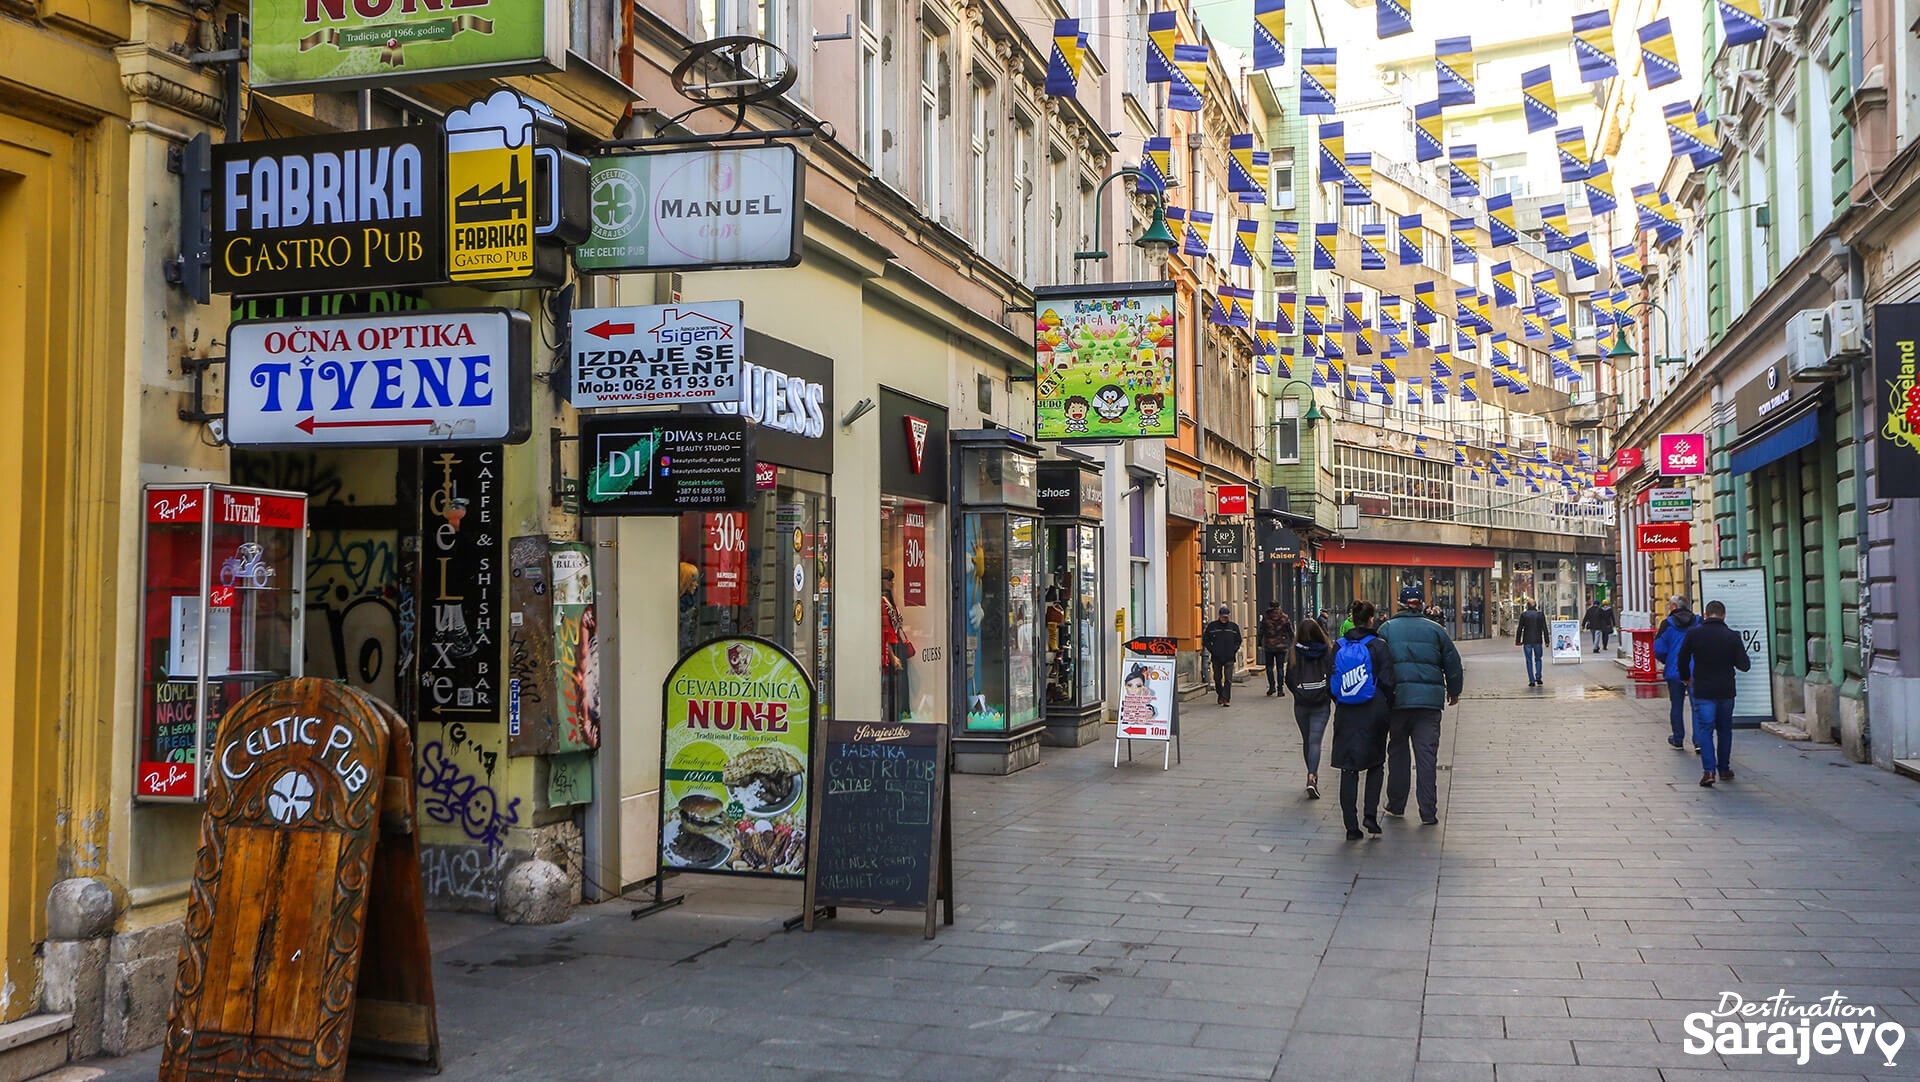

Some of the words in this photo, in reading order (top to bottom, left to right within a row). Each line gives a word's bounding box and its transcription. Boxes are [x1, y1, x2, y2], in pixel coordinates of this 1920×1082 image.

[346, 30, 379, 42] Tradicija
[380, 29, 392, 39] od
[417, 25, 445, 37] godine
[225, 143, 422, 232] FABRIKA
[661, 194, 782, 218] MANUEL
[455, 223, 528, 251] FABRIKA
[579, 248, 596, 258] THE
[597, 247, 626, 257] CELTIC
[1073, 297, 1140, 315] Kindergarten
[264, 326, 351, 354] OČNA
[357, 323, 475, 350] OPTIKA
[578, 347, 684, 366] IZDAJE
[696, 344, 734, 361] SE
[578, 365, 639, 380] FOR
[651, 361, 734, 377] RENT
[578, 380, 619, 394] Mob:
[623, 379, 655, 392] 062
[662, 378, 682, 390] 61
[688, 376, 709, 389] 93
[714, 375, 734, 387] 61
[596, 389, 716, 401] www.sigenx.com
[706, 431, 742, 442] PLACE
[704, 444, 731, 452] STUDIO
[609, 451, 641, 477] DI
[478, 452, 493, 522] CAFFE
[1042, 488, 1070, 497] shoes
[153, 494, 197, 519] Ray-Ban
[476, 533, 493, 546] &
[922, 646, 941, 662] GUESS
[475, 662, 491, 704] BAR
[1341, 664, 1367, 690] NIKE
[675, 675, 800, 699] ĆEVABDŽINICA
[687, 699, 788, 733] NUNE
[695, 732, 731, 741] Traditional
[854, 724, 911, 742] Sarajevsko
[1150, 727, 1167, 736] 10m
[221, 716, 321, 780] CELTIC
[321, 724, 368, 793] PUB
[842, 743, 906, 759] FABRIKA
[144, 766, 187, 792] Ray-Ban
